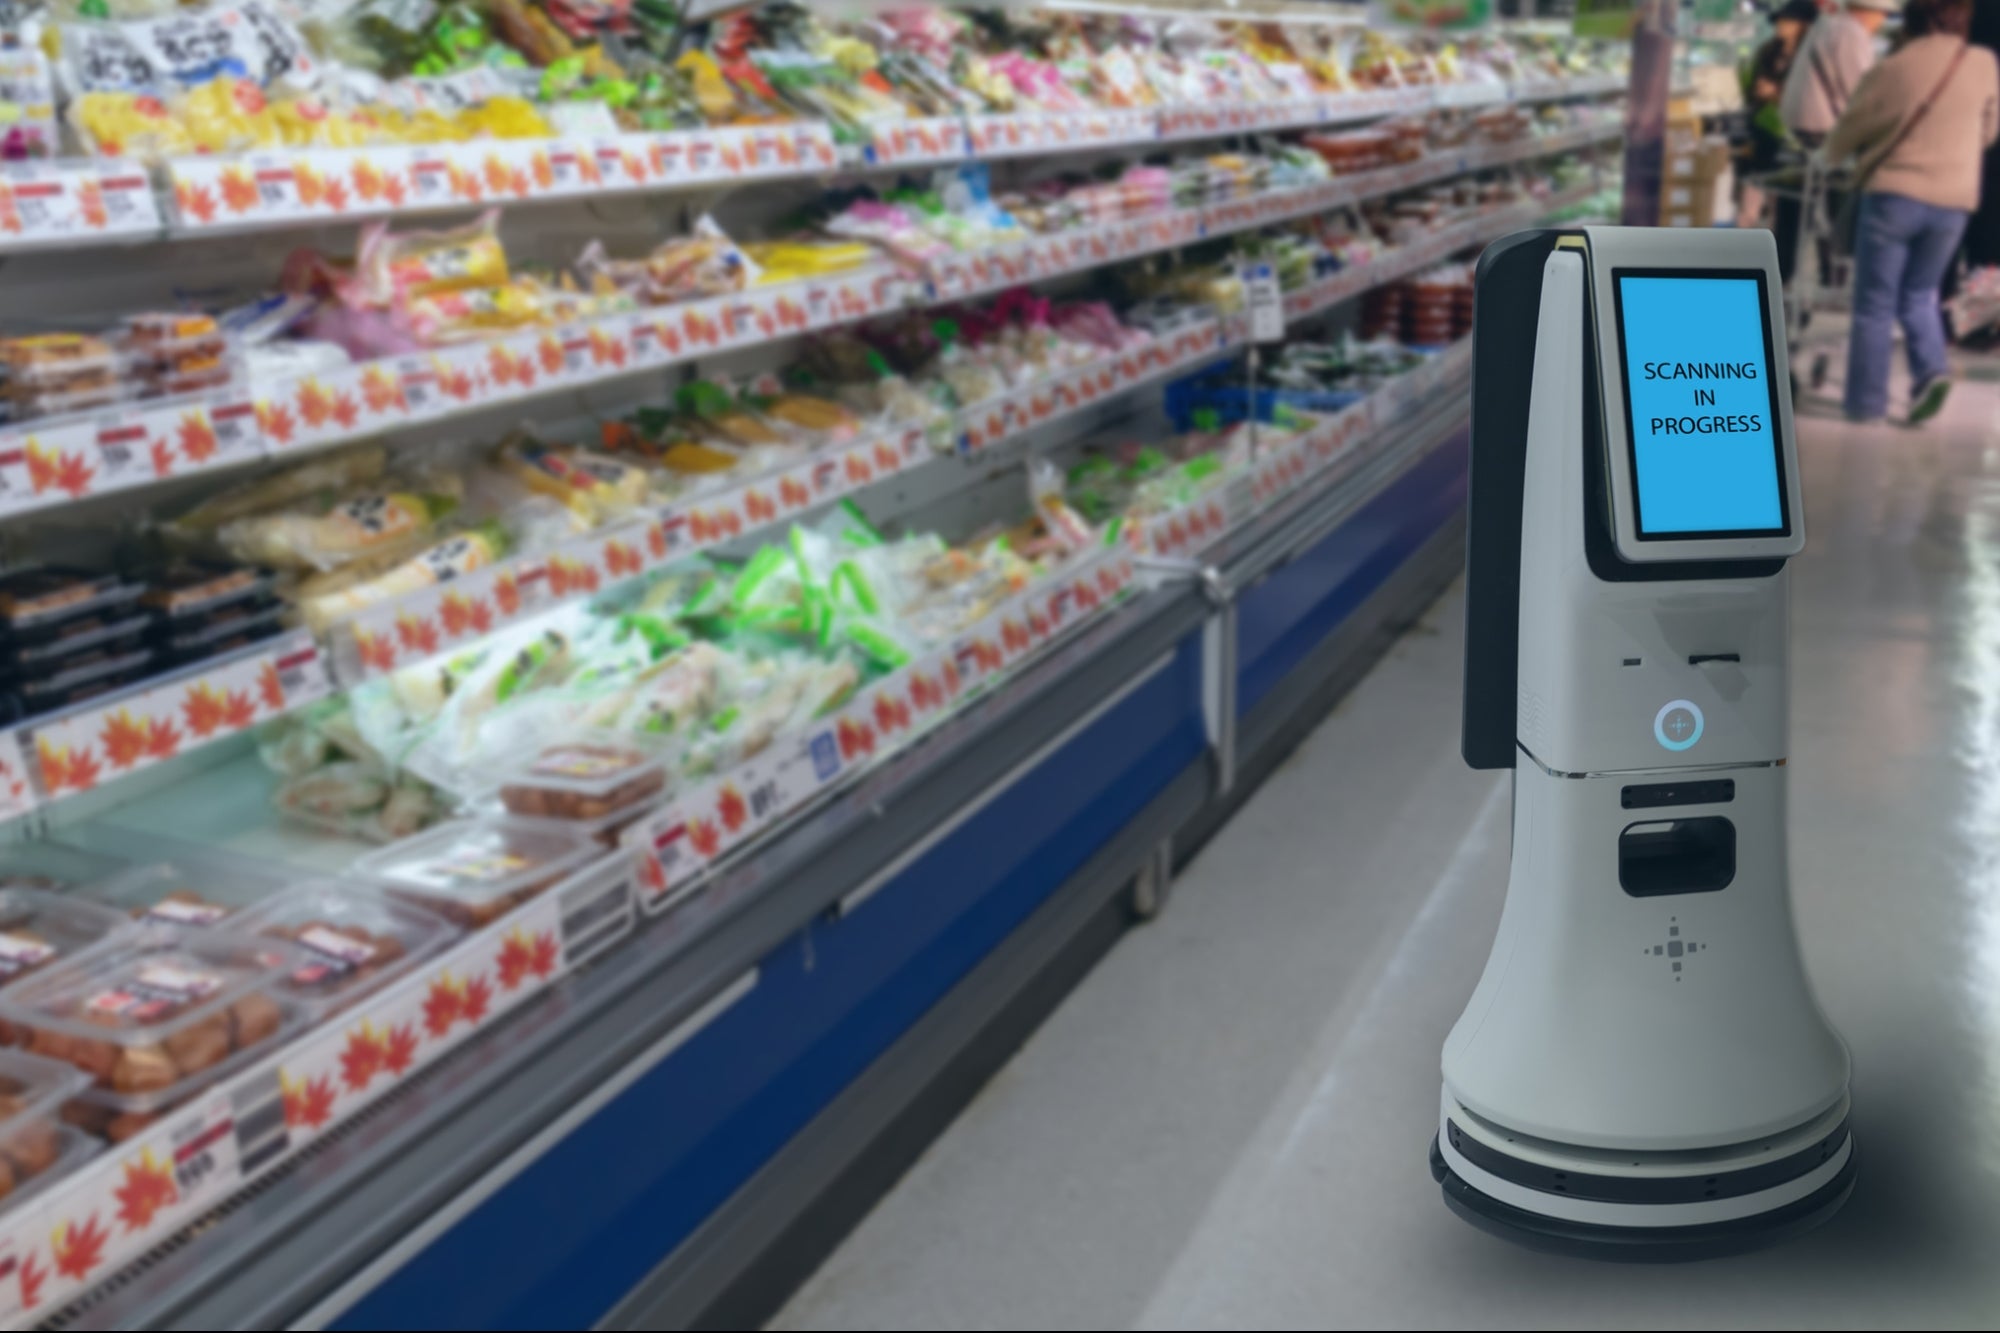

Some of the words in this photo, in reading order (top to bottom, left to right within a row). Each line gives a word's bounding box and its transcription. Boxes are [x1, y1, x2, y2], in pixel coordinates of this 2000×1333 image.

[1644, 362, 1757, 380] SCANNING
[1694, 389, 1715, 406] IN
[1651, 415, 1762, 435] PROGRESS
